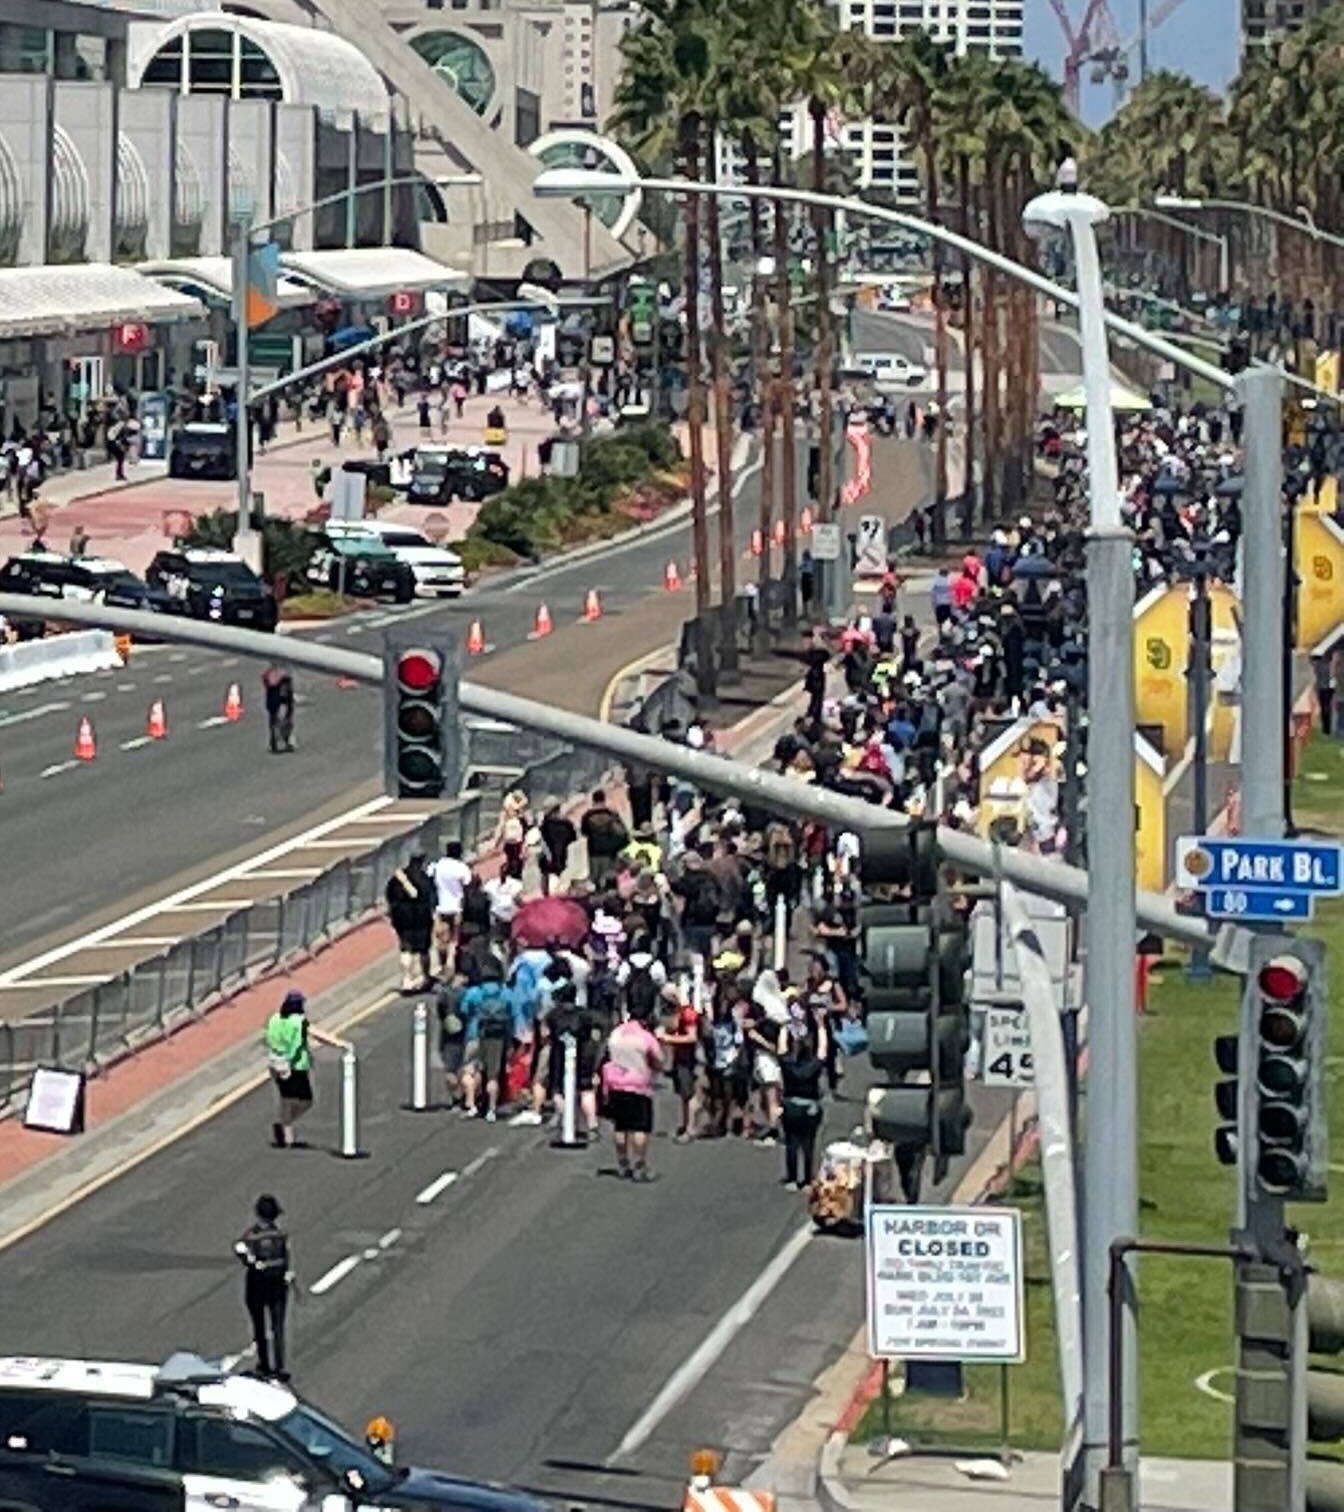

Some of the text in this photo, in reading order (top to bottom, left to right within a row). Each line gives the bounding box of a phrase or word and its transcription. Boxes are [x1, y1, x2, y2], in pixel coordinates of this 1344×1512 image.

[1220, 848, 1285, 881] PARK
[988, 1052, 1035, 1081] 45
[883, 1219, 968, 1236] HARBOR
[898, 1238, 990, 1257] CLOSED
